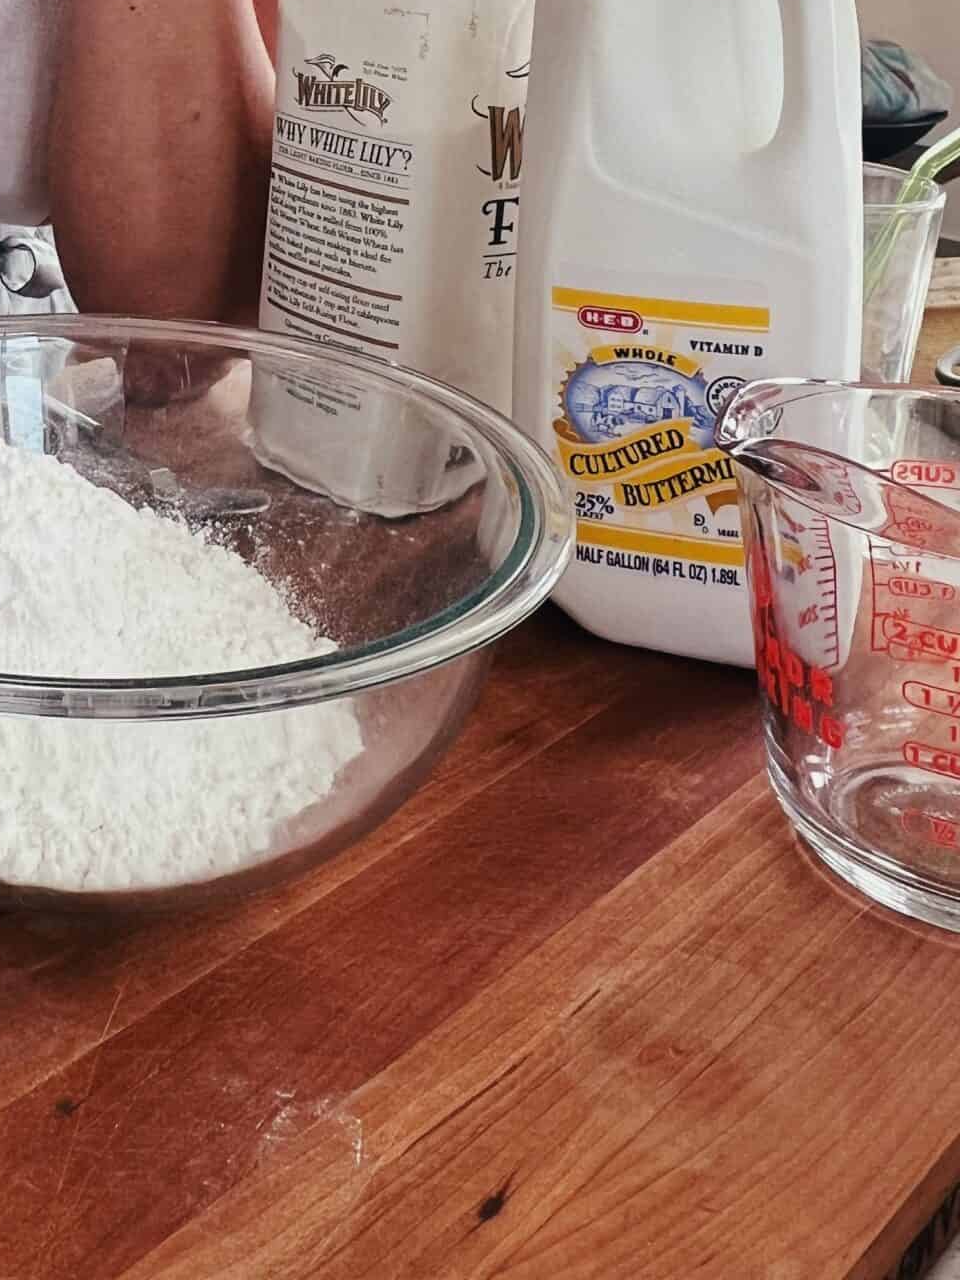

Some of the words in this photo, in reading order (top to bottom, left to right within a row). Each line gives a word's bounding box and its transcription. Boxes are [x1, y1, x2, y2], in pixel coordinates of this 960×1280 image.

[276, 116, 307, 145] WHY
[310, 127, 359, 159] WHITE
[613, 347, 676, 367] WHOLE
[690, 340, 749, 356] VITAMIN
[754, 346, 763, 357] D
[569, 428, 685, 477] CULTURED
[623, 457, 737, 507] BUTTERMI
[576, 544, 604, 563] HALF
[606, 550, 650, 574] GALLON
[652, 557, 670, 577] (64
[672, 562, 686, 579] FL
[689, 565, 708, 585] OZ)
[711, 567, 741, 587] 1.89L
[919, 631, 958, 654] CU
